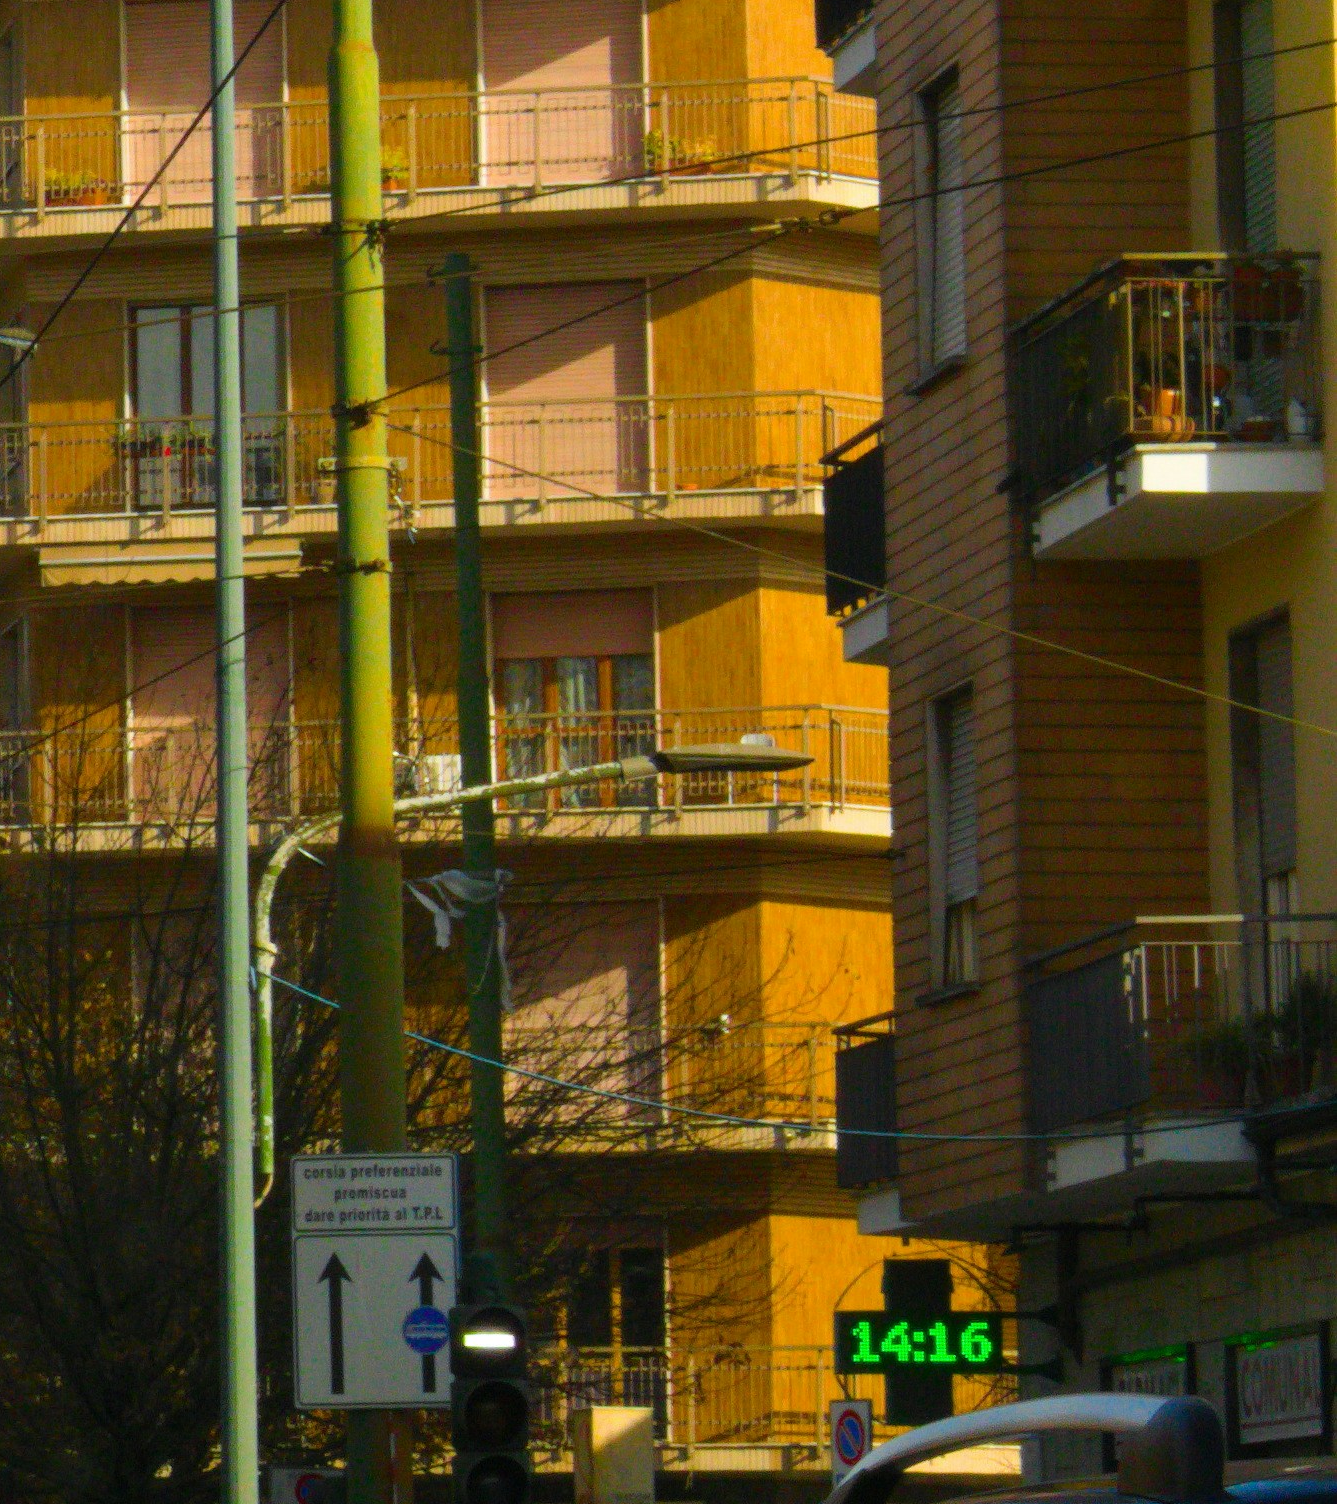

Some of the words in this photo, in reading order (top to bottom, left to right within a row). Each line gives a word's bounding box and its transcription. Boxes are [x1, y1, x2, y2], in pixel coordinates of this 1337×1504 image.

[303, 1164, 345, 1180] corsia
[349, 1162, 442, 1181] preferenziale
[334, 1185, 406, 1202] promiscua
[304, 1208, 335, 1223] dare
[394, 1207, 408, 1221] al
[851, 1321, 992, 1362] 14:16
